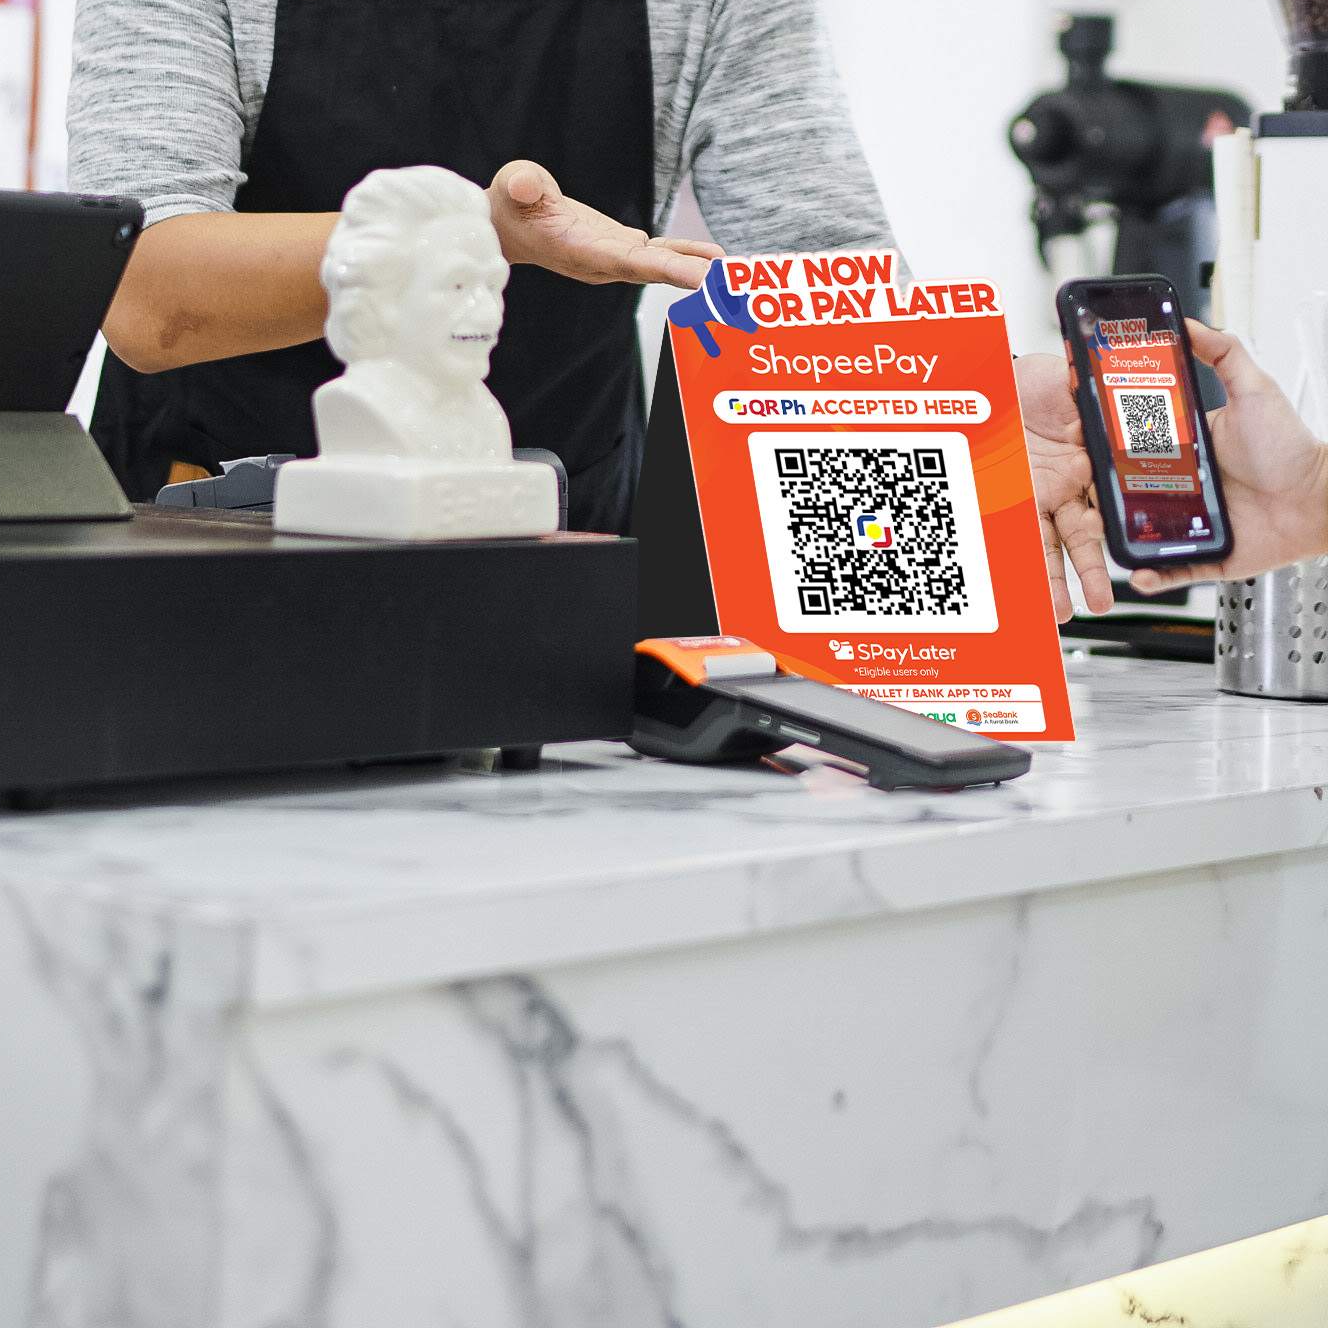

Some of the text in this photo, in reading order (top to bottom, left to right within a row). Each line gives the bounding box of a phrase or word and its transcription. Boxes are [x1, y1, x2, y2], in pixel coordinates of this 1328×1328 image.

[727, 255, 892, 291] PAY NOW
[752, 283, 998, 323] OR PAY LATER
[1100, 319, 1146, 336] PAY NOW
[1108, 331, 1176, 348] OR PAY LATER
[748, 344, 939, 383] ShopeePay
[1109, 355, 1161, 371] ShopeePay
[1128, 376, 1157, 384] ACCEPTED
[1157, 376, 1172, 384] HERE
[810, 399, 918, 416] ACCEPTED
[924, 399, 978, 416] HERE
[857, 643, 957, 665] SPayLater
[892, 669, 918, 677] users
[919, 667, 939, 678] only
[912, 688, 945, 698] BANK
[947, 688, 970, 698] APP
[972, 688, 989, 698] TO
[991, 688, 1012, 698] PAY
[919, 712, 957, 724] aya
[982, 711, 1018, 719] SeaBank
